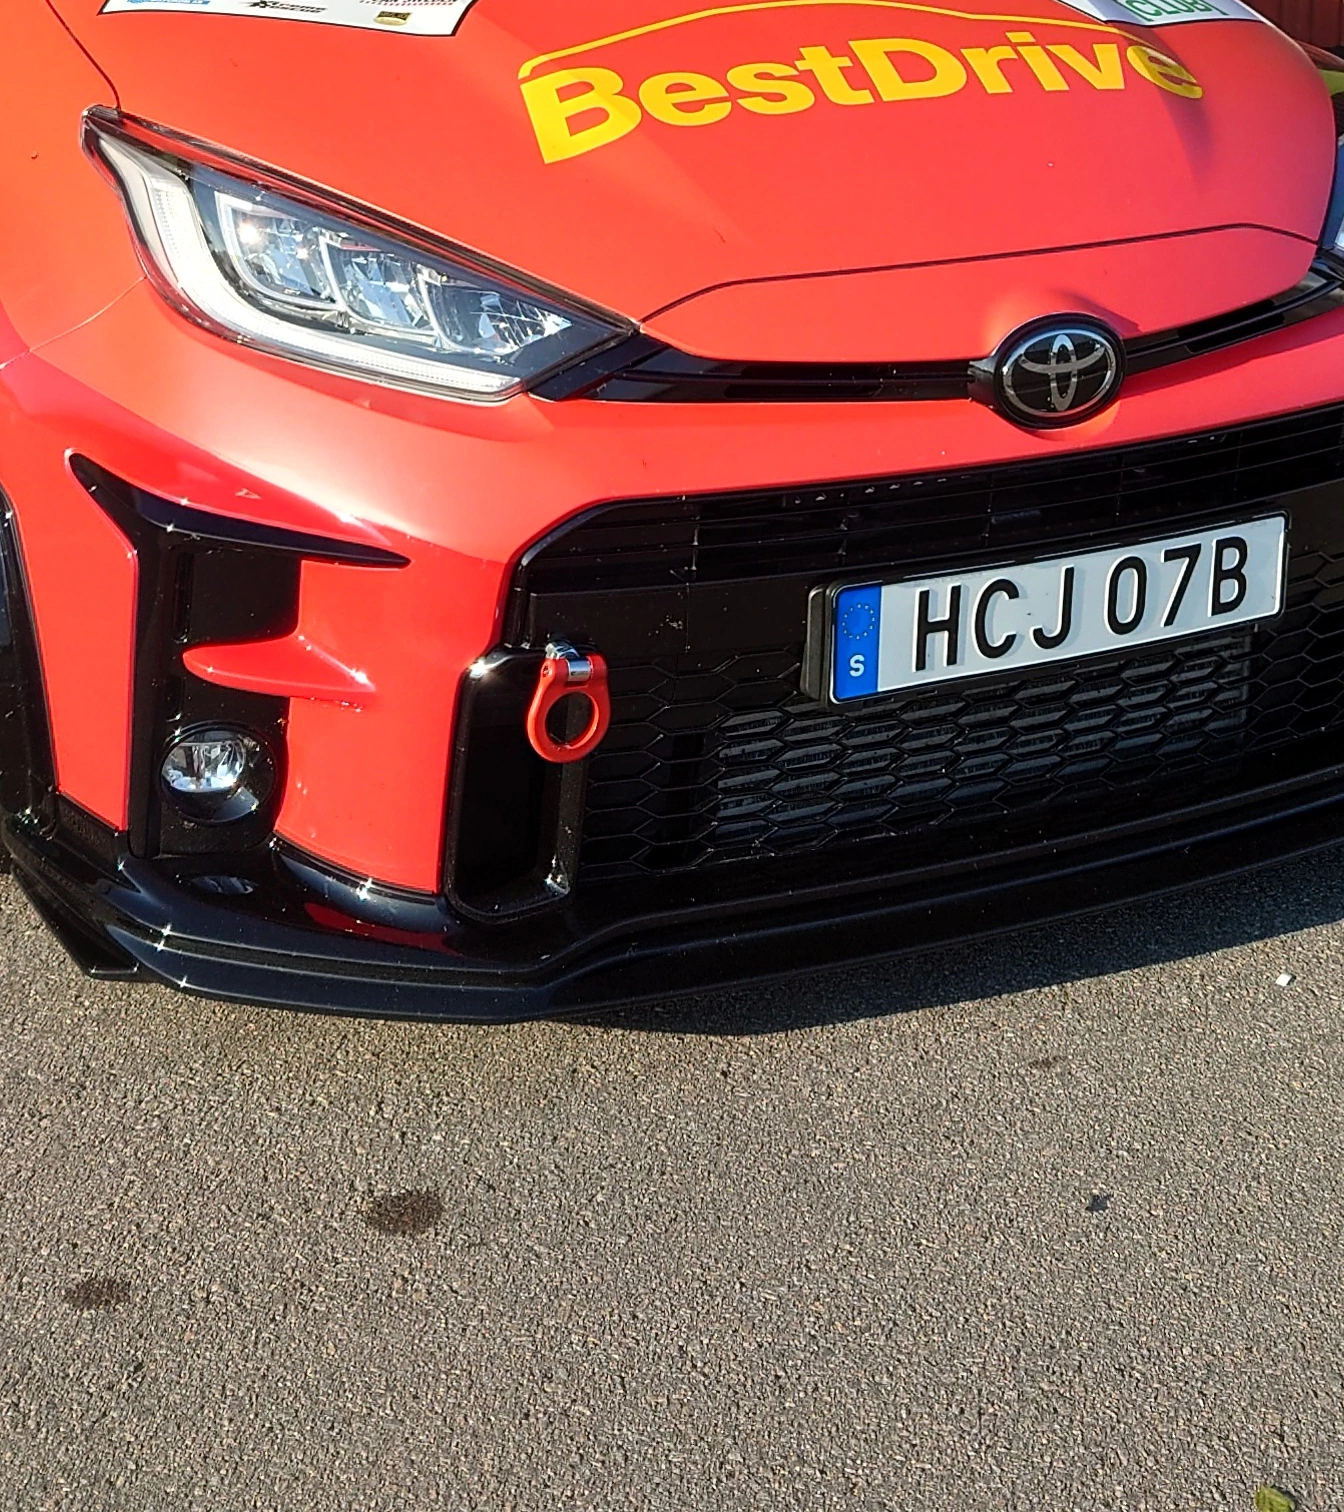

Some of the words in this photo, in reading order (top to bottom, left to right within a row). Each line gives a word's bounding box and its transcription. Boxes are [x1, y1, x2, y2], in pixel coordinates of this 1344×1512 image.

[524, 32, 1203, 165] BestDrive
[849, 654, 865, 678] S
[912, 565, 1075, 673] HCJ
[1105, 536, 1249, 636] 07B
